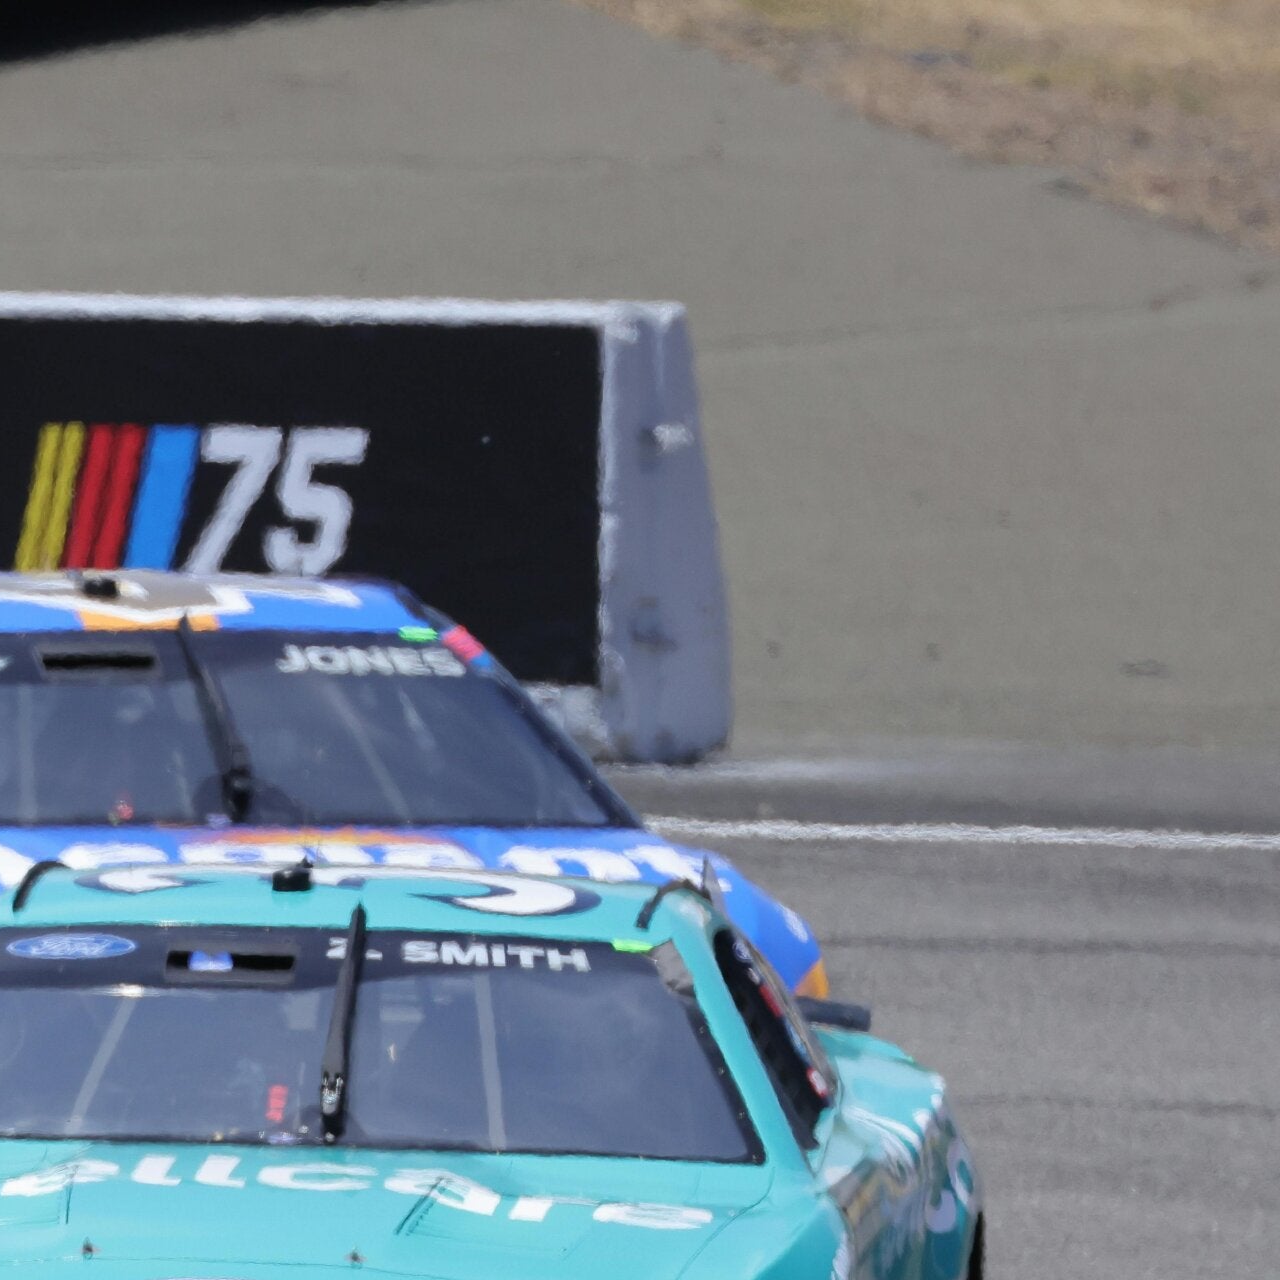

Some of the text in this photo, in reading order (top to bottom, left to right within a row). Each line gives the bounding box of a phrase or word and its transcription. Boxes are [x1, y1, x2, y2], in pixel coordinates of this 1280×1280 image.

[183, 425, 370, 575] 75
[275, 644, 467, 677] JONES
[401, 940, 592, 972] SMITH
